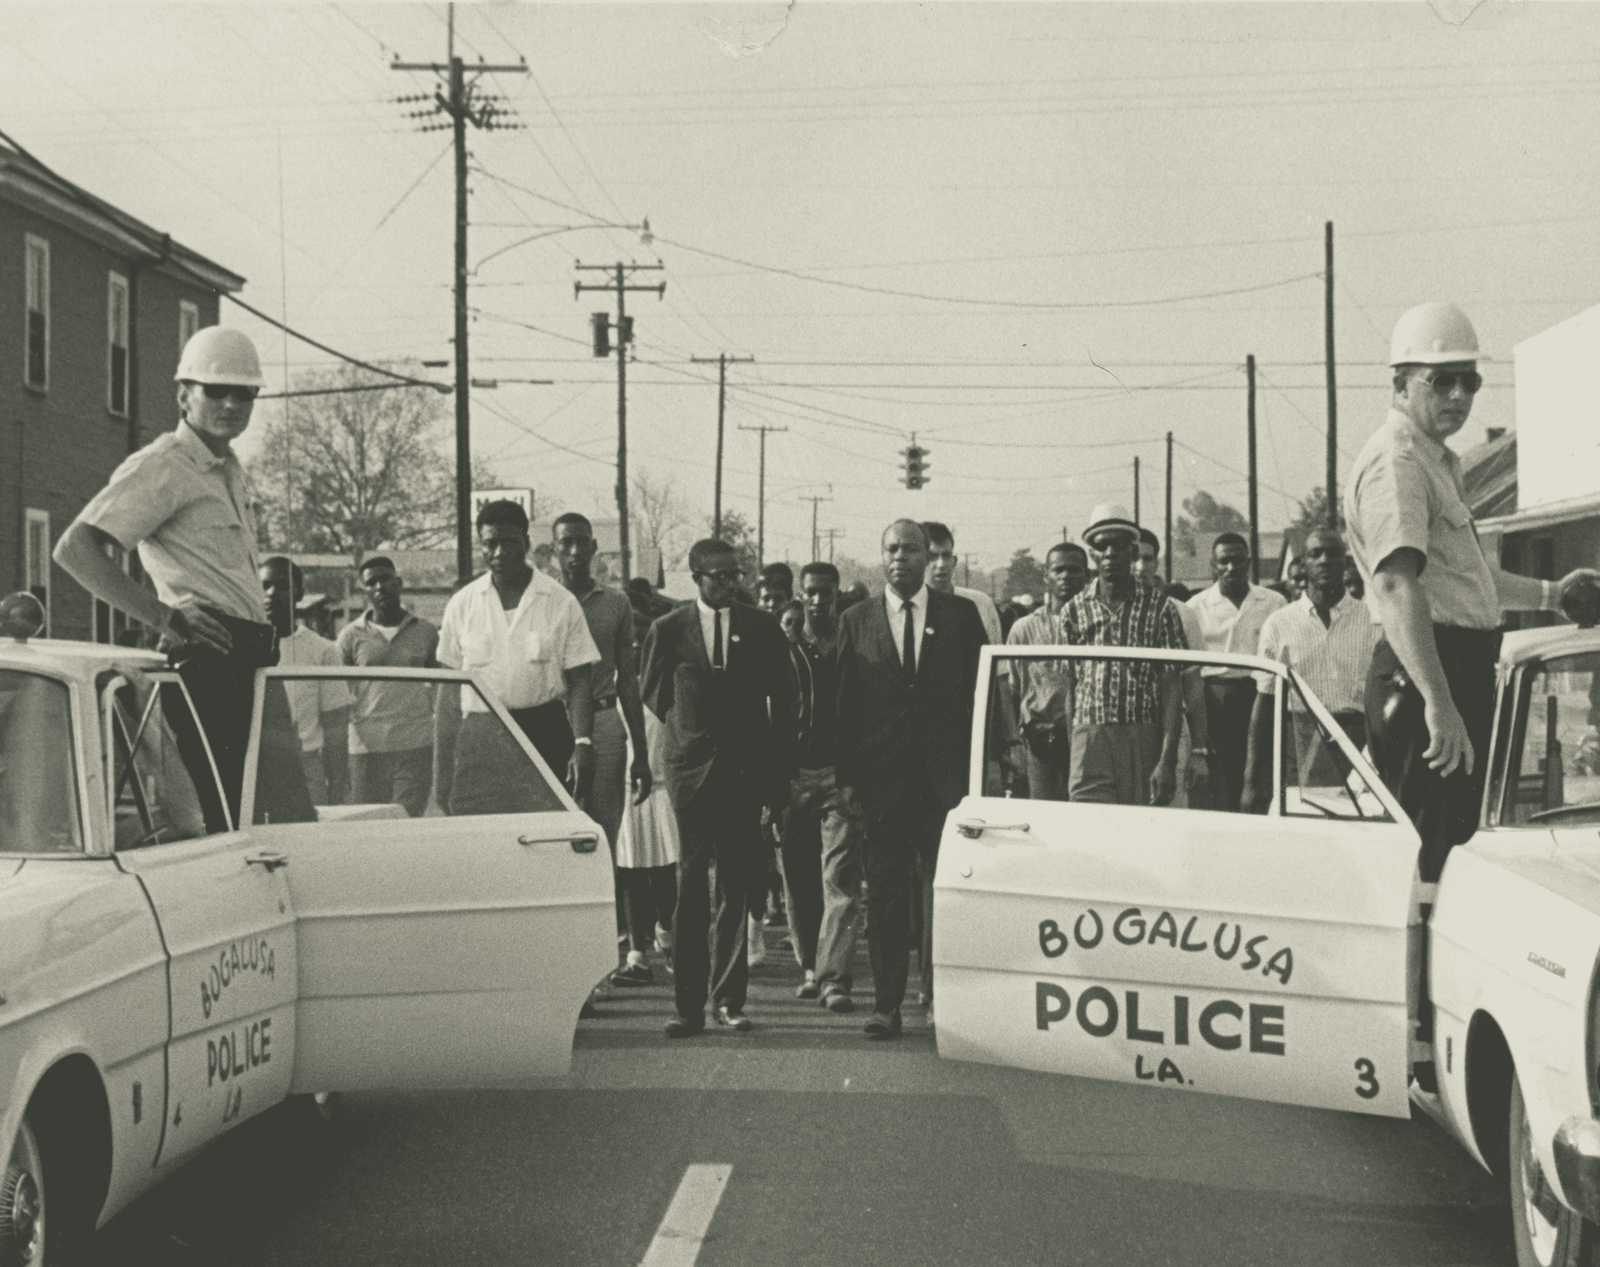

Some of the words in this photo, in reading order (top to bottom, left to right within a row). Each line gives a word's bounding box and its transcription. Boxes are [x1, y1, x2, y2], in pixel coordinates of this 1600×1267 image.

[201, 937, 275, 1018] BOGALUSA
[1039, 907, 1294, 985] BOGALUSA
[207, 1017, 271, 1087] POLICE
[1035, 982, 1286, 1056] POLICE
[1134, 1055, 1194, 1086] LA.
[1355, 1058, 1380, 1099] 3
